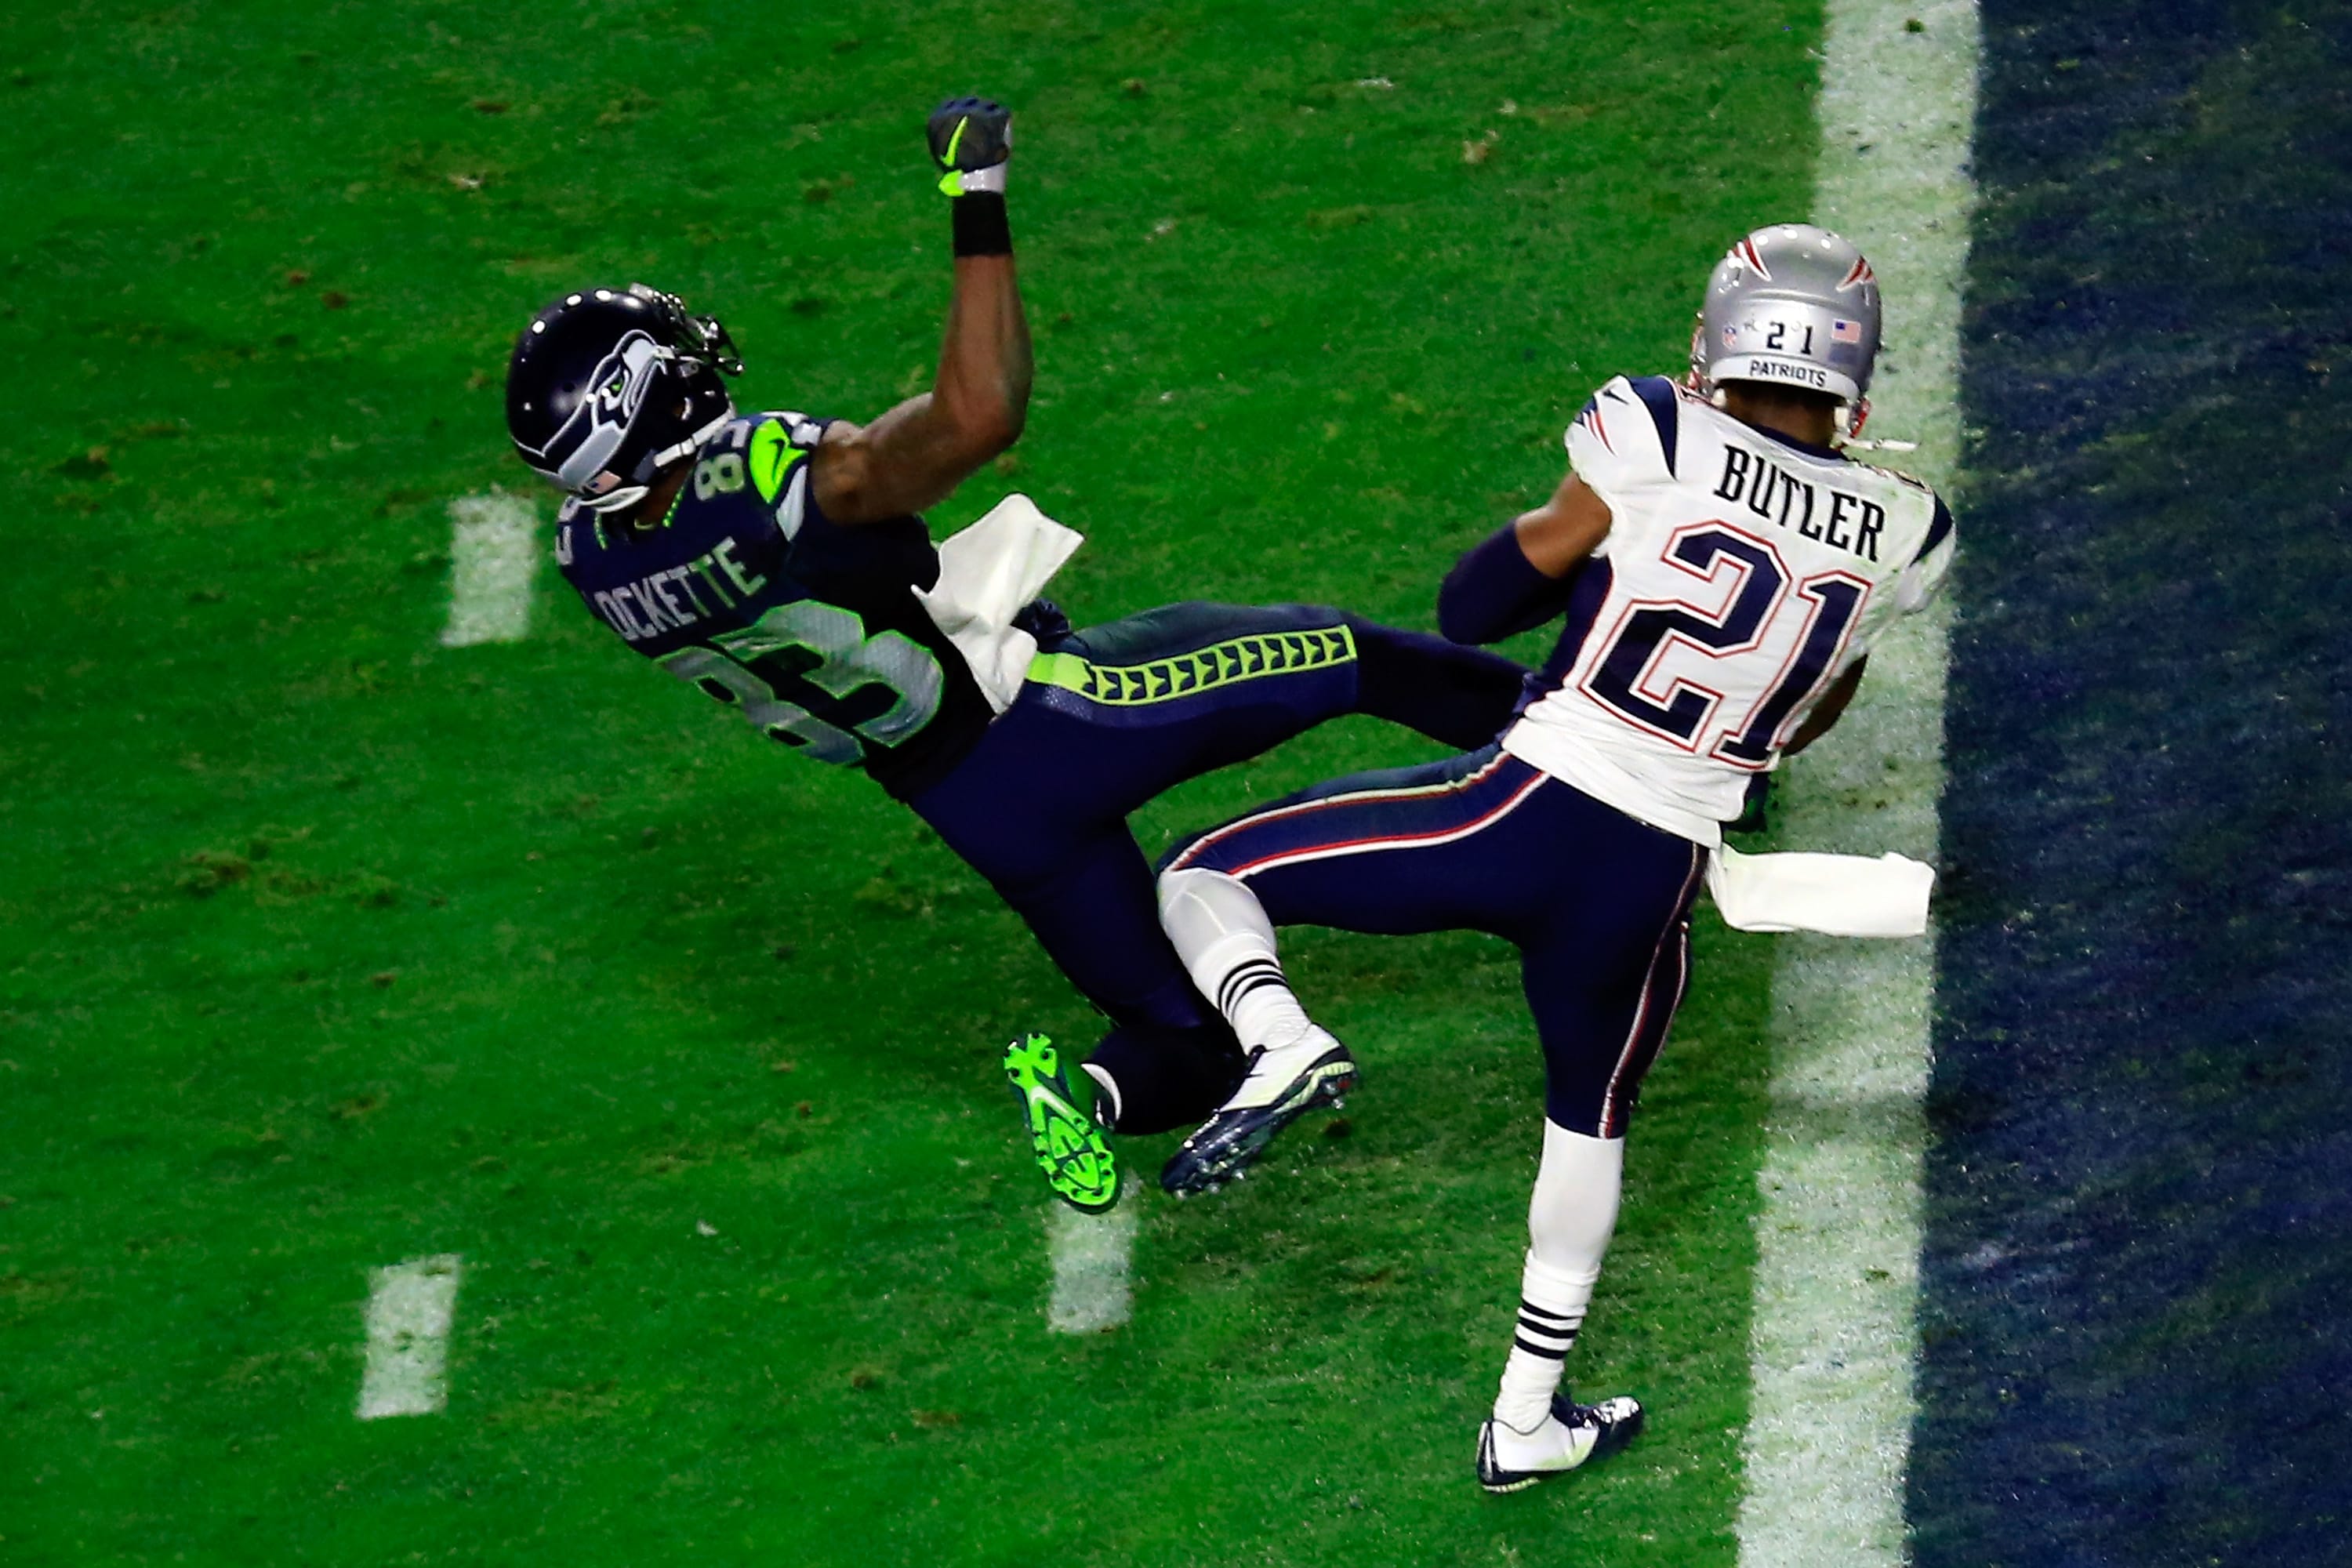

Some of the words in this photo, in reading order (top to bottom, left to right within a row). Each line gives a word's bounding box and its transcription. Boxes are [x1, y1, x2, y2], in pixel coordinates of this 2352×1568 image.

[1749, 360, 1827, 387] PATRIOTS
[1766, 321, 1813, 355] 21
[1713, 444, 1885, 563] BUTLER
[583, 535, 767, 641] OCKETTE
[654, 599, 944, 765] 83
[1578, 519, 1873, 770] 21
